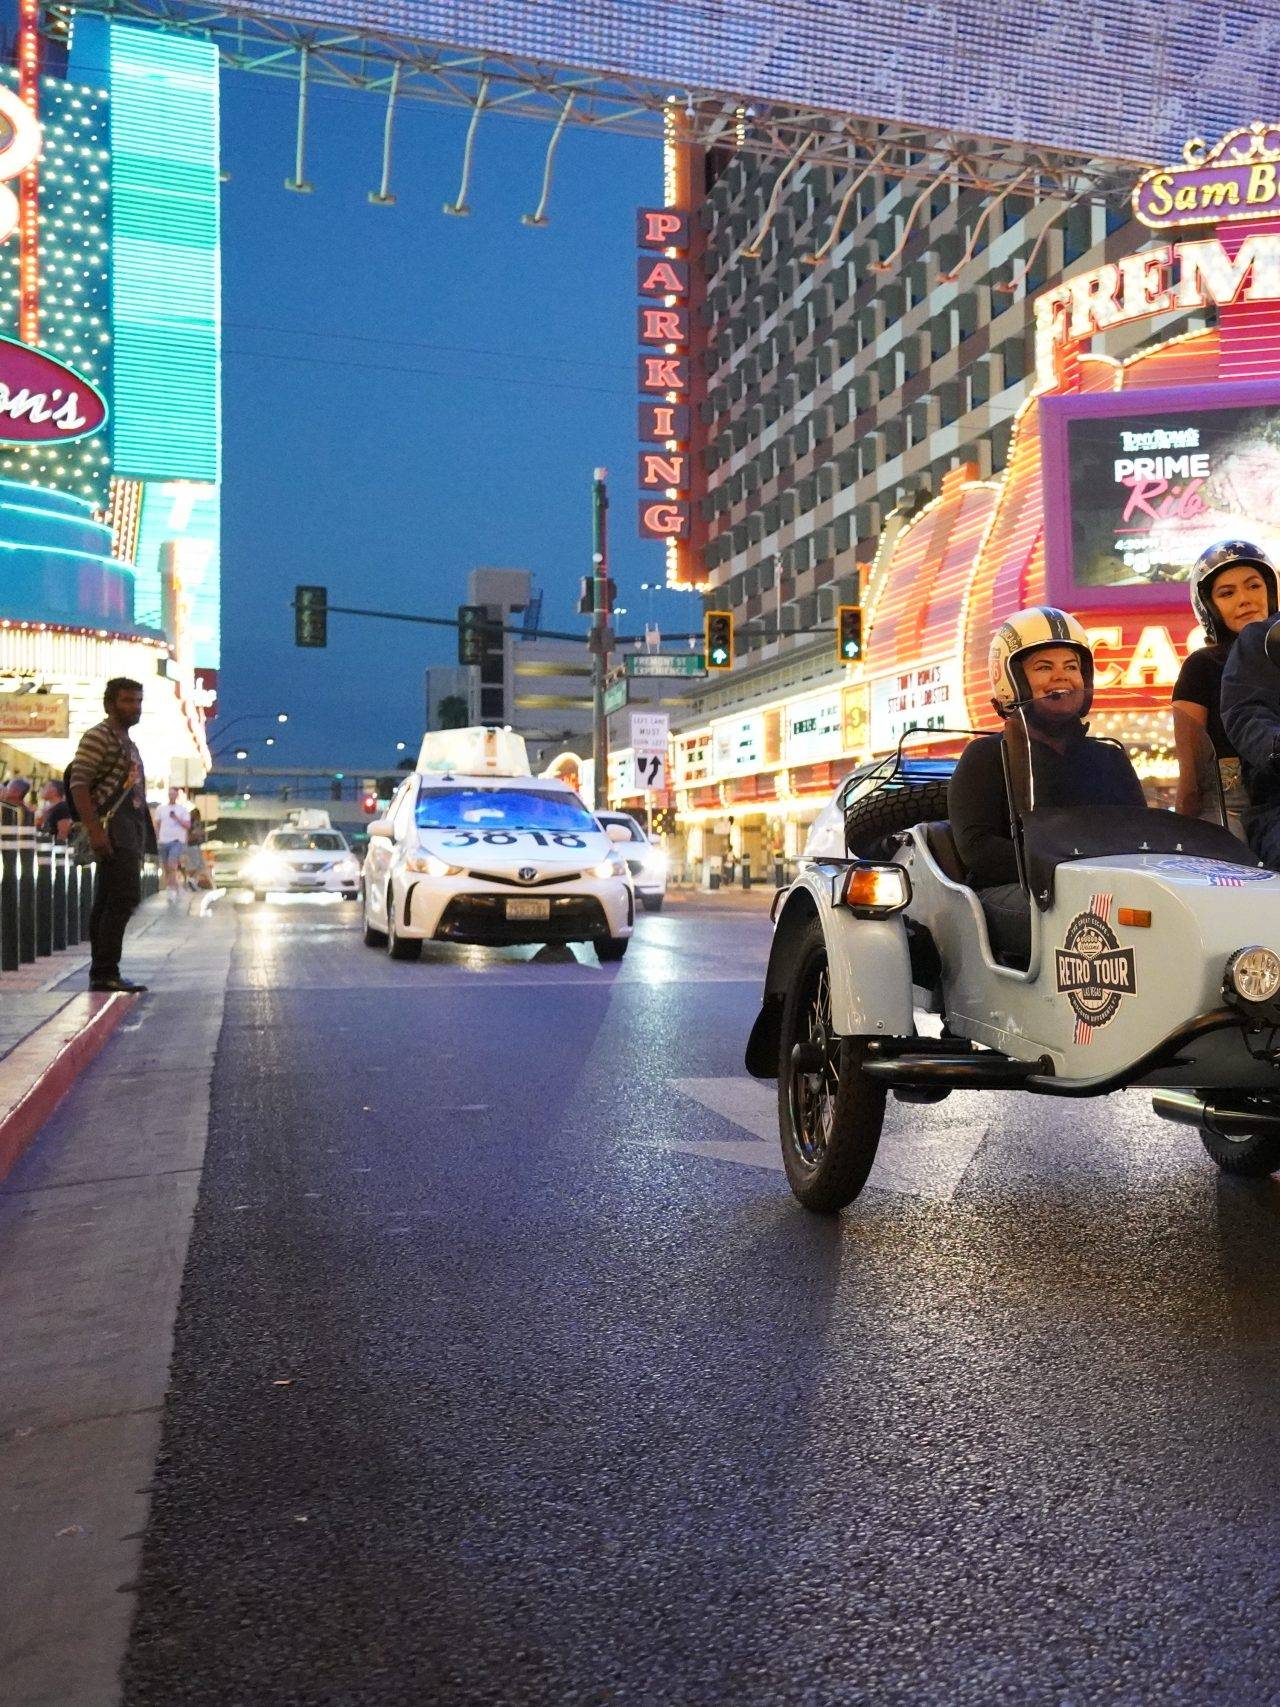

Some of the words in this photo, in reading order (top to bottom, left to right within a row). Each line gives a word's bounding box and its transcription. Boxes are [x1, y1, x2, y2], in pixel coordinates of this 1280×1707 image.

[1148, 173, 1240, 216] Sam
[643, 213, 685, 533] PARKING
[1114, 454, 1210, 482] PRIME
[1120, 477, 1212, 523] Rib
[640, 727, 661, 736] MUST
[442, 829, 588, 849] 3818
[1058, 956, 1091, 987] RETRO
[1094, 957, 1130, 987] TOUR
